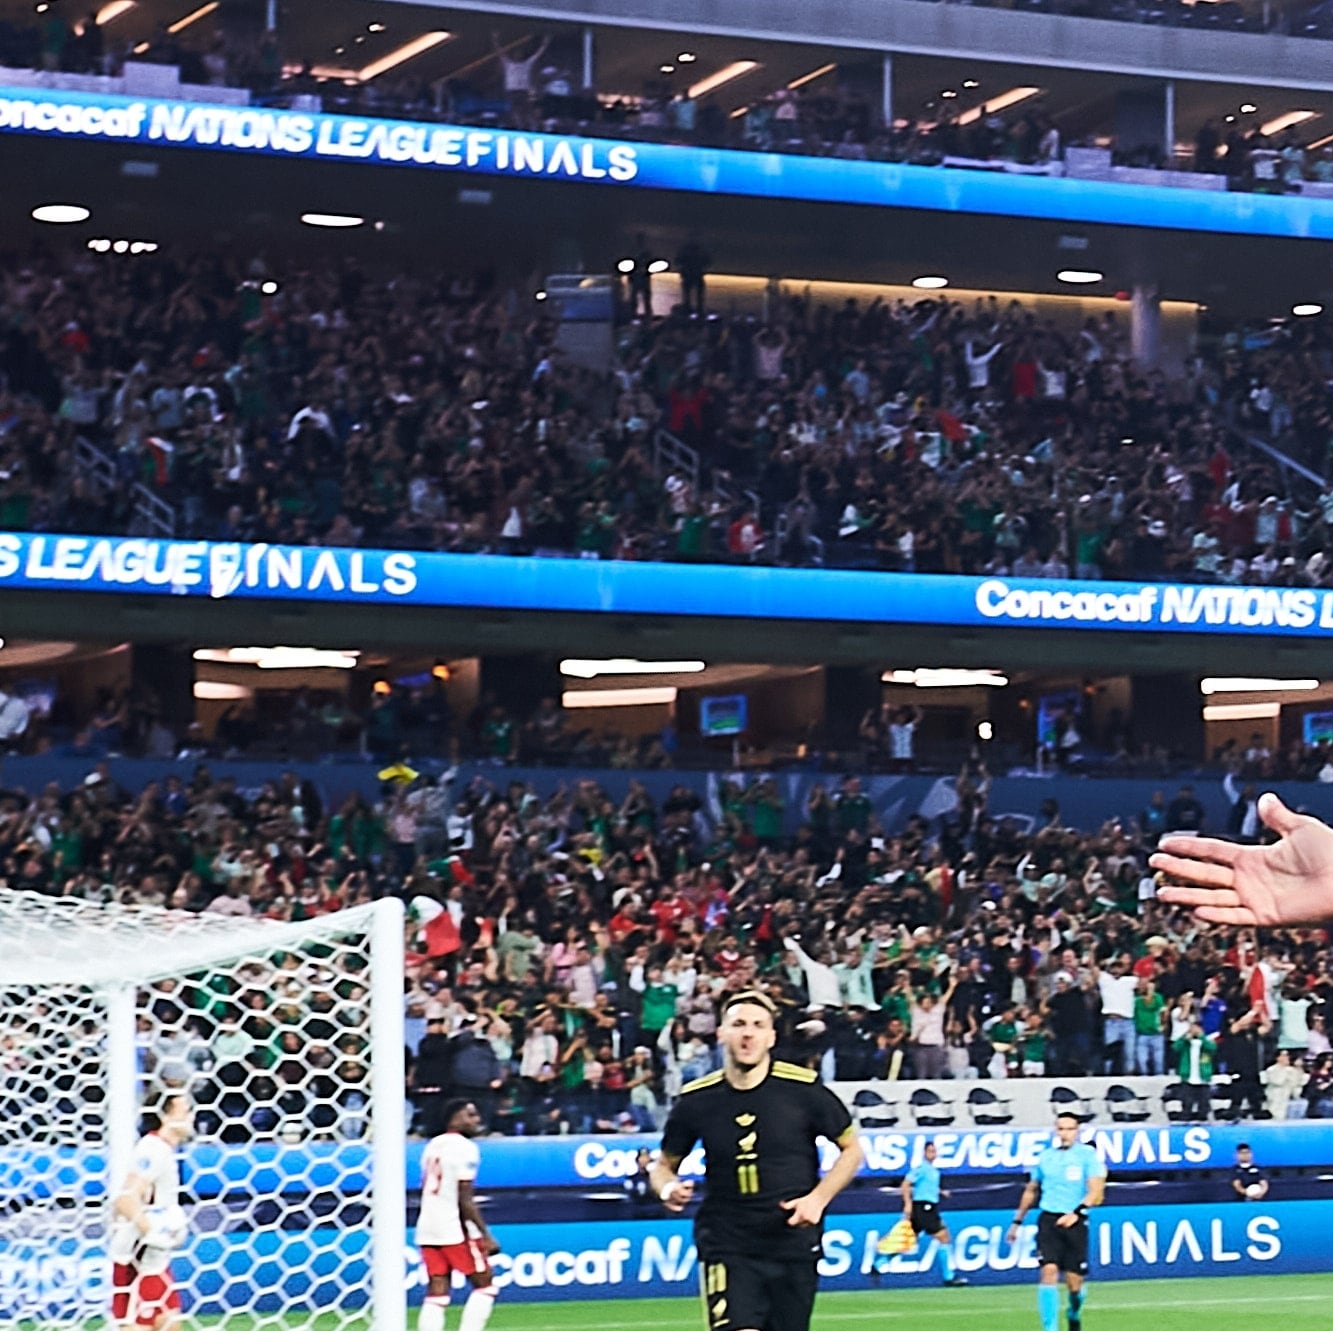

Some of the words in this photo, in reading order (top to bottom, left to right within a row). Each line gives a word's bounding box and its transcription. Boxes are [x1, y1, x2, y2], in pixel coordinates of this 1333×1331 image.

[148, 103, 314, 153] NATIONS
[316, 119, 464, 167] LEAGUE
[465, 131, 638, 182] FINALS
[25, 536, 207, 586] LEAGUE
[975, 579, 1158, 622] Concacaf
[1159, 586, 1317, 629] NATIONS
[737, 1163, 759, 1195] 11
